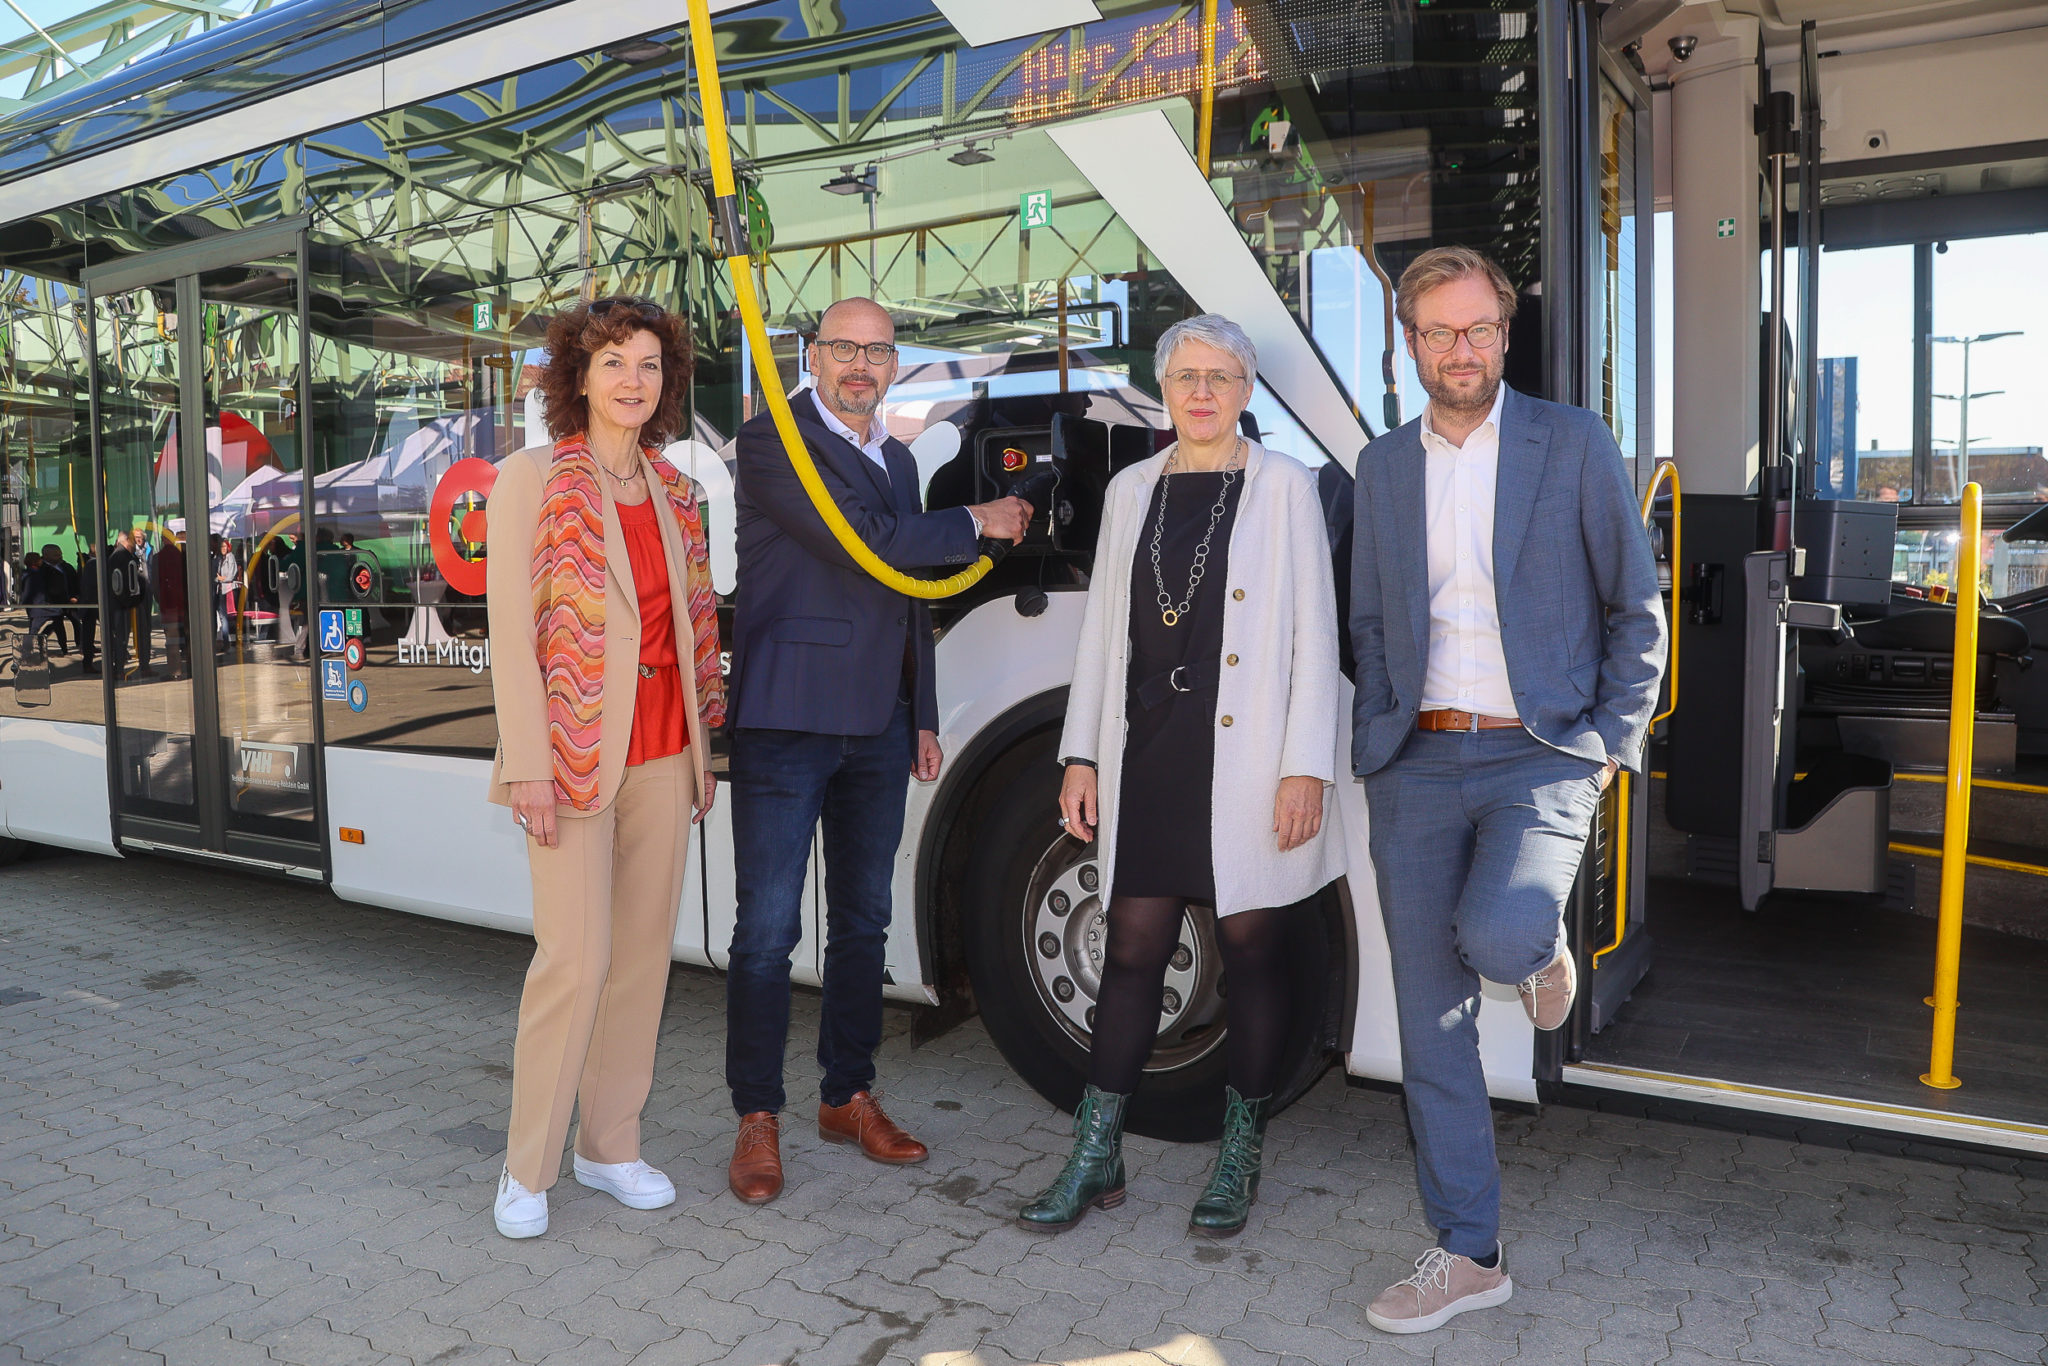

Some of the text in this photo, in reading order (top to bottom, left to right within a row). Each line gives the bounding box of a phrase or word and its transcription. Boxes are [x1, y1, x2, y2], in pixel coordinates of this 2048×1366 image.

[398, 638, 490, 674] Ein Mitgl
[241, 749, 272, 773] VHH
